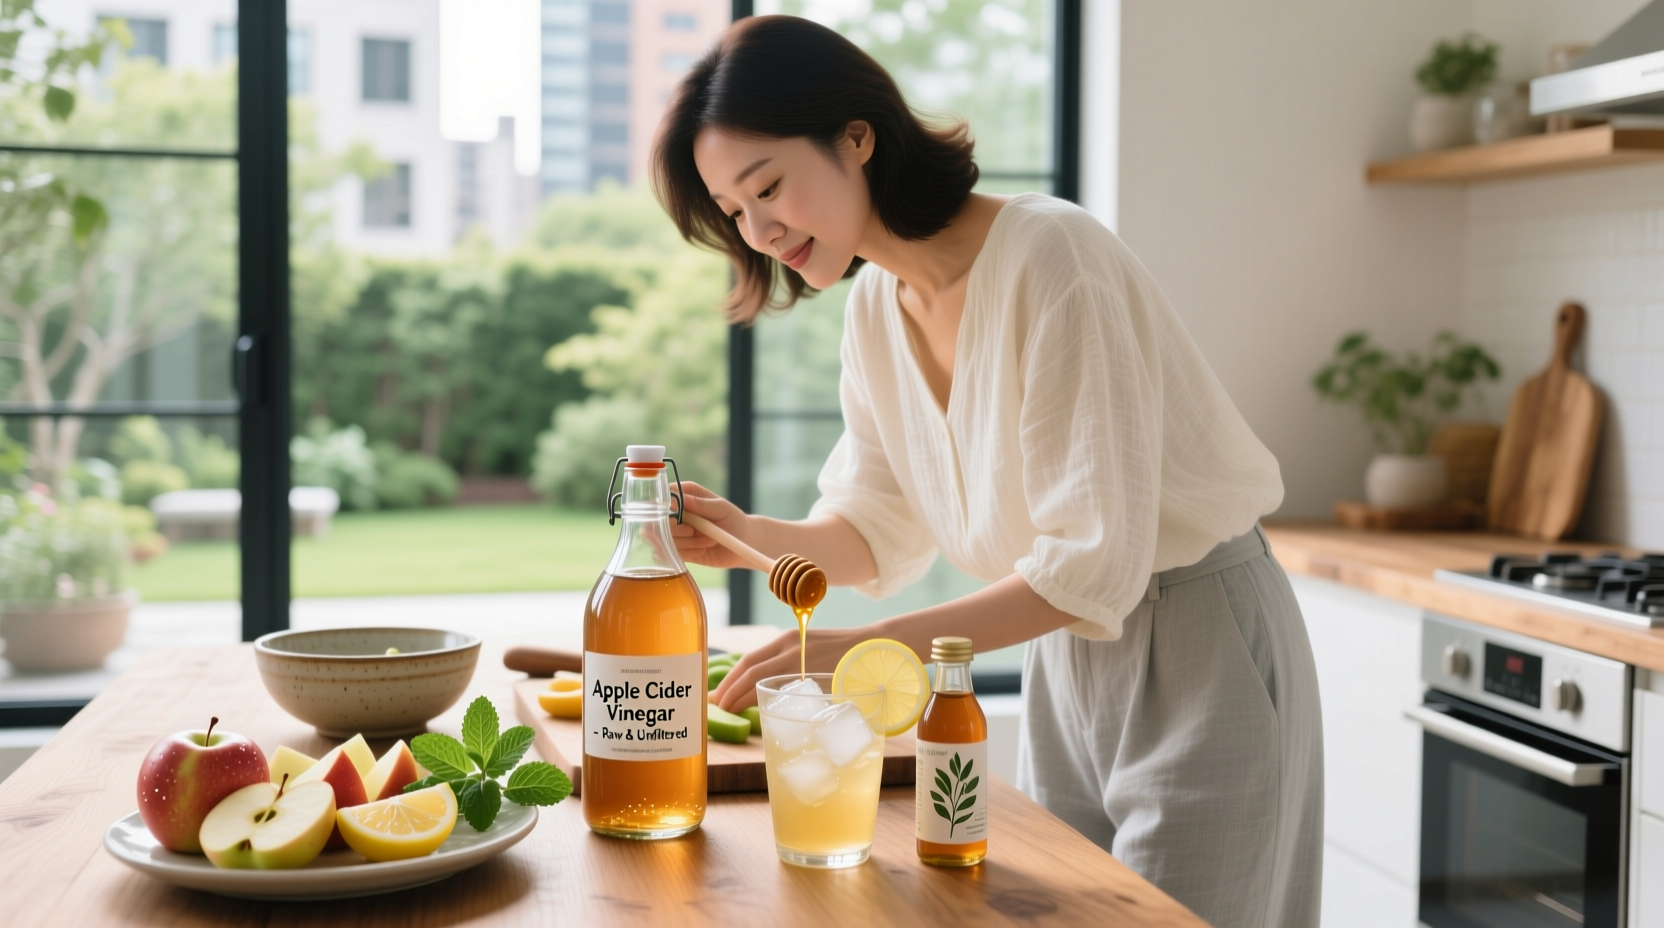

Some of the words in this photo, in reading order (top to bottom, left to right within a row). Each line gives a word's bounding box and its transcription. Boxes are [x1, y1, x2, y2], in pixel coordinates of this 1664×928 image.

[592, 679, 640, 703] Apple
[645, 681, 692, 699] Cider
[606, 704, 675, 727] Vinegar
[602, 727, 624, 740] Raw
[625, 729, 633, 741] &
